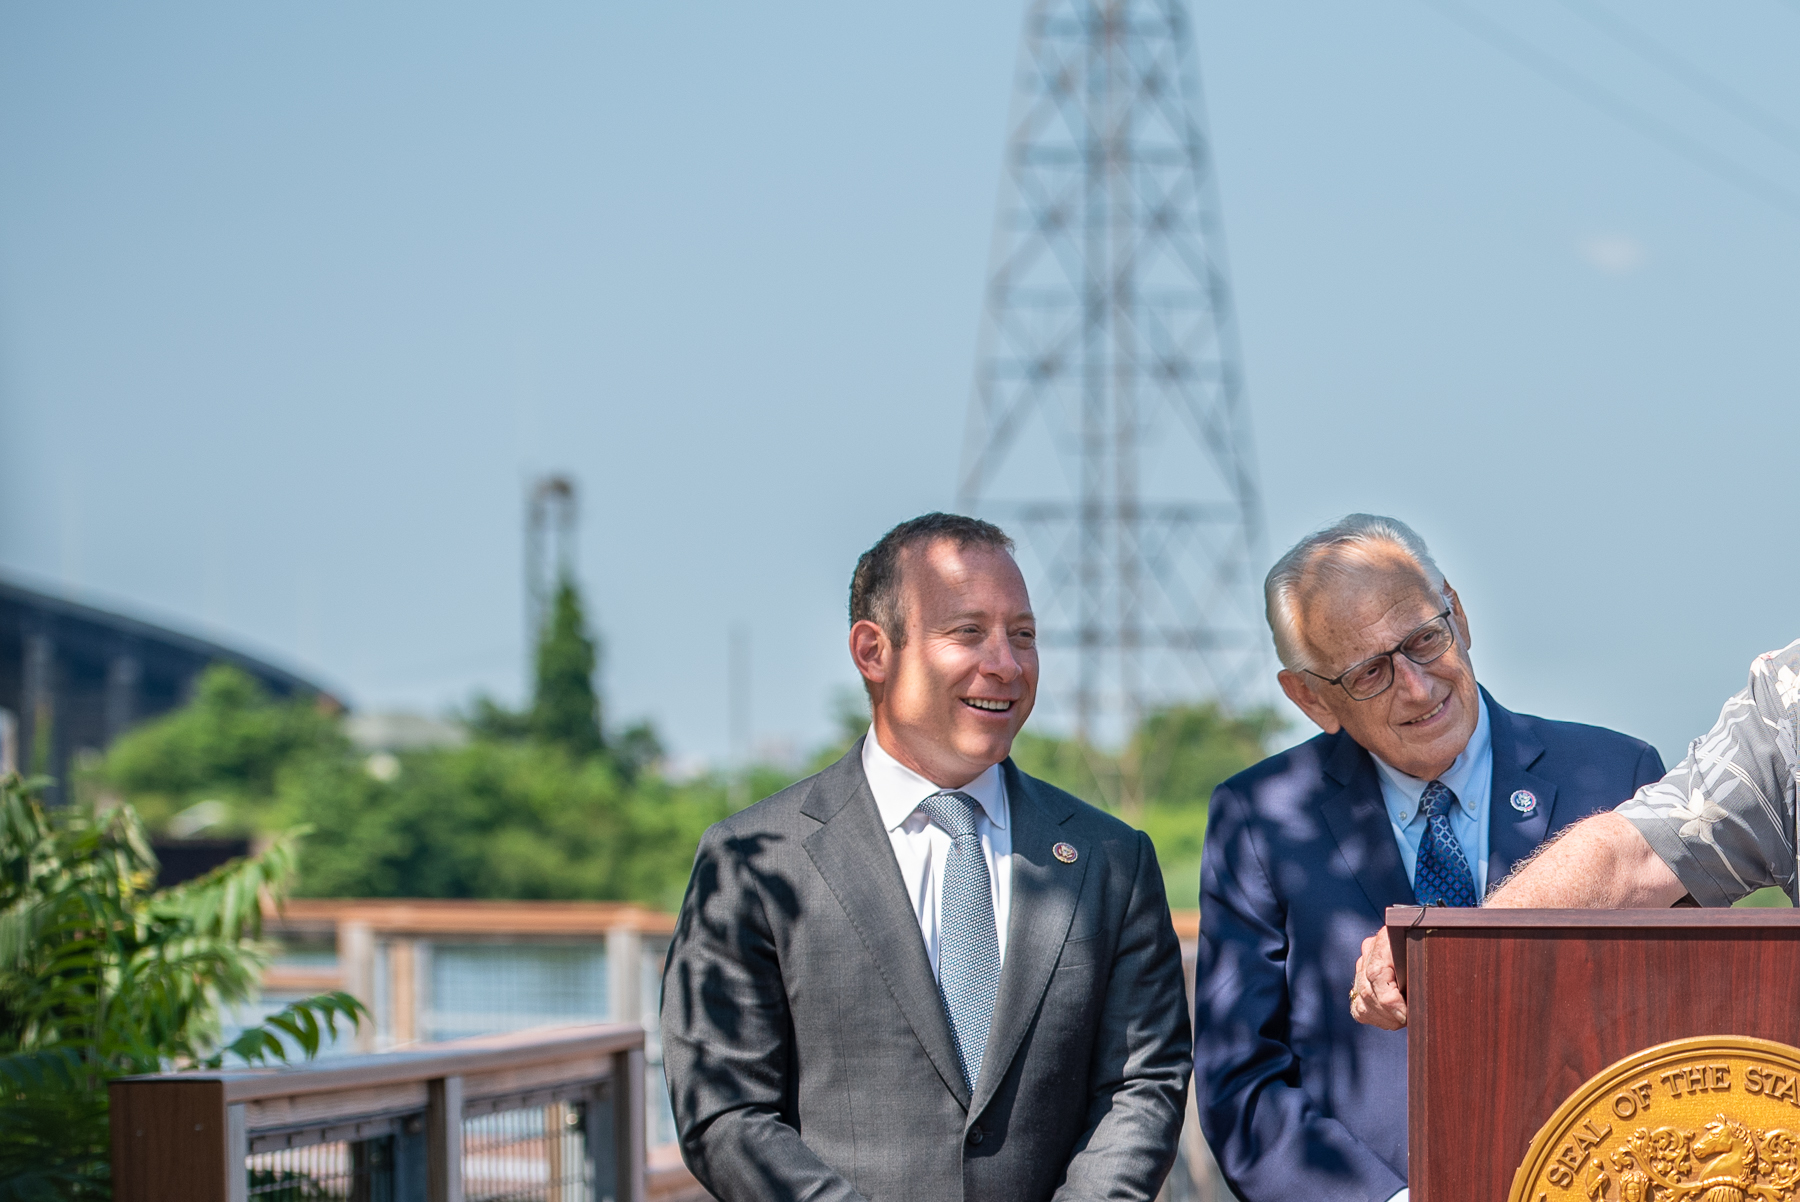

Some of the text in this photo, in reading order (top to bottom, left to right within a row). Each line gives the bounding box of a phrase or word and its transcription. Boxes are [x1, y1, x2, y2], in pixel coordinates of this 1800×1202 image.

[1547, 1118, 1613, 1188] SEAL
[1612, 1080, 1653, 1118] OF
[1660, 1064, 1731, 1097] THE
